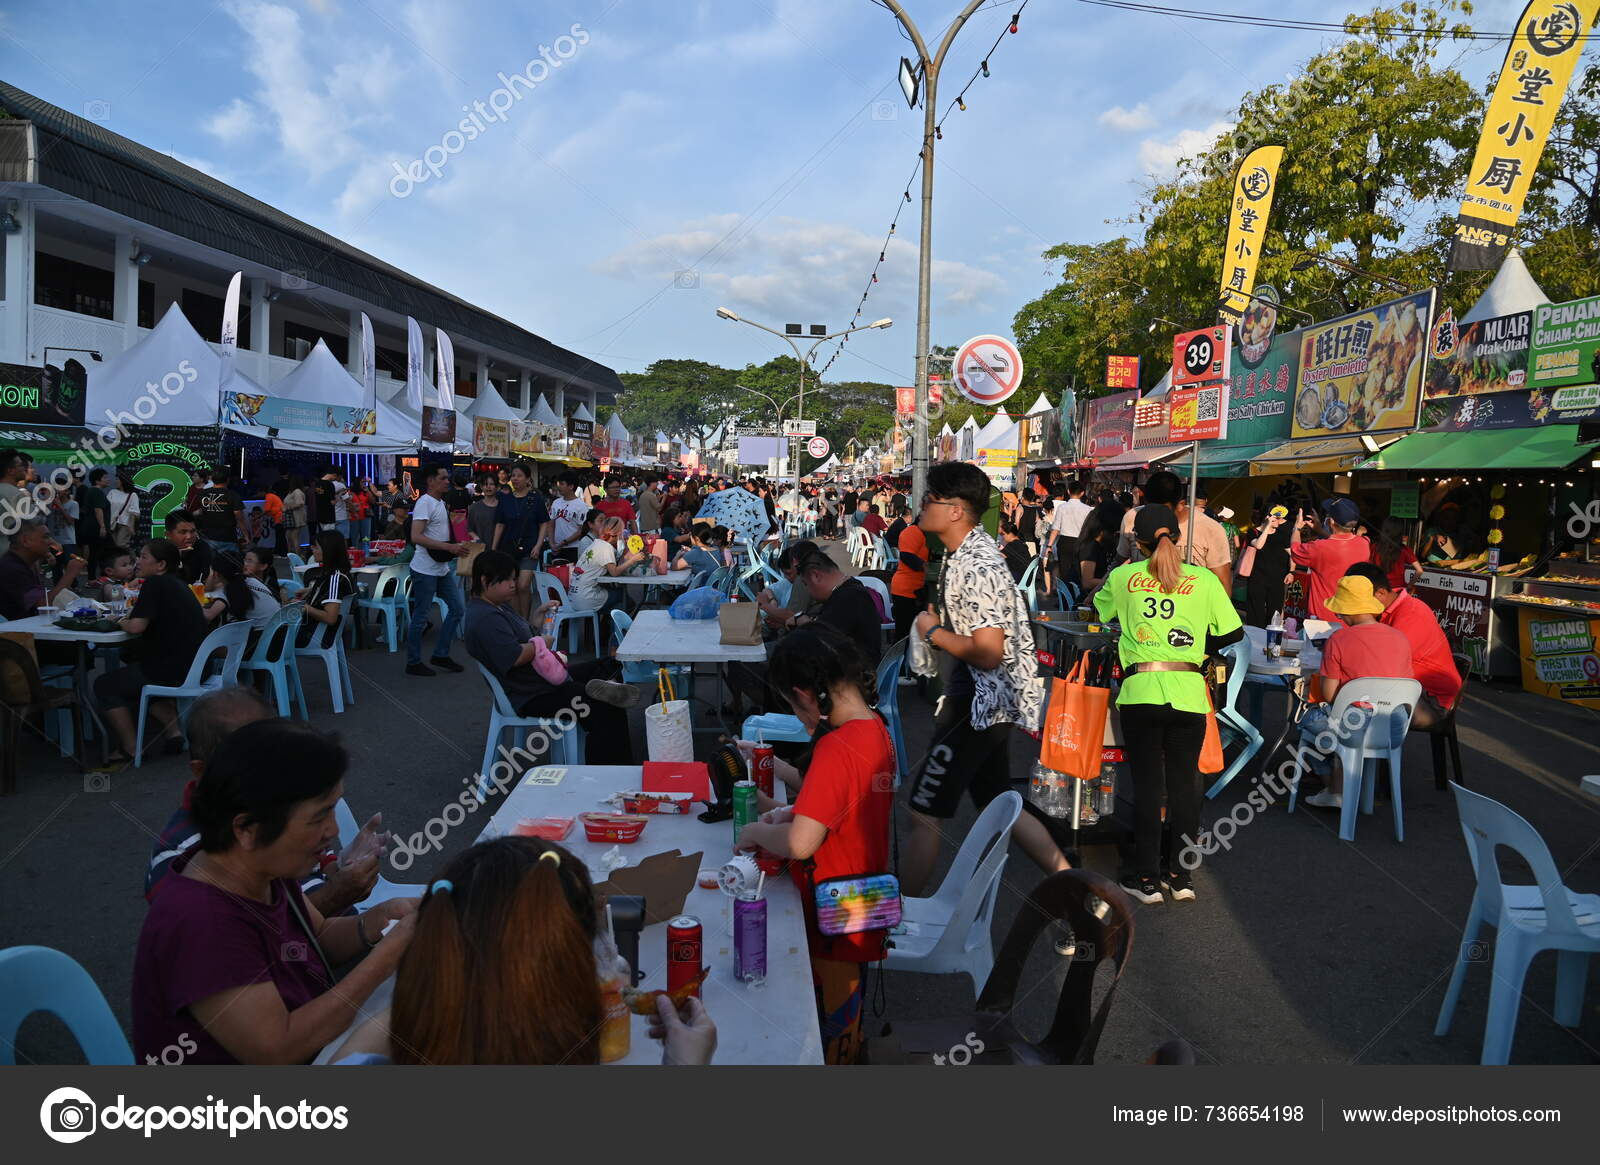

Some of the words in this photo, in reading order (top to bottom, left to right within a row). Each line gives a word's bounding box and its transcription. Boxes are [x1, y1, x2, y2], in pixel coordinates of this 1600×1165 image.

[1475, 66, 1553, 195] 堂小厨
[1455, 224, 1508, 246] ANG'S
[1230, 207, 1259, 290] 堂小厨
[1484, 314, 1529, 342] MUAR
[1187, 341, 1211, 368] 39
[1315, 320, 1374, 367] 蚝仔煎
[1476, 336, 1528, 357] Otak-Otak
[1303, 369, 1328, 385] Oyster
[1330, 358, 1367, 378] Omelette
[0, 385, 39, 408] ON
[1559, 388, 1586, 398] FIRST
[1588, 385, 1599, 396] IN
[1256, 400, 1286, 417] Chicken
[1440, 577, 1453, 589] Fish
[1463, 580, 1480, 593] Lala
[1143, 596, 1175, 620] 39
[1446, 595, 1483, 615] MUAR
[1435, 608, 1476, 637] tak-Otak
[1531, 621, 1586, 639] PENANG
[1541, 657, 1568, 670] FIRST
[1568, 655, 1581, 669] IN
[1543, 668, 1585, 682] KUCHING
[912, 745, 953, 809] CALM
